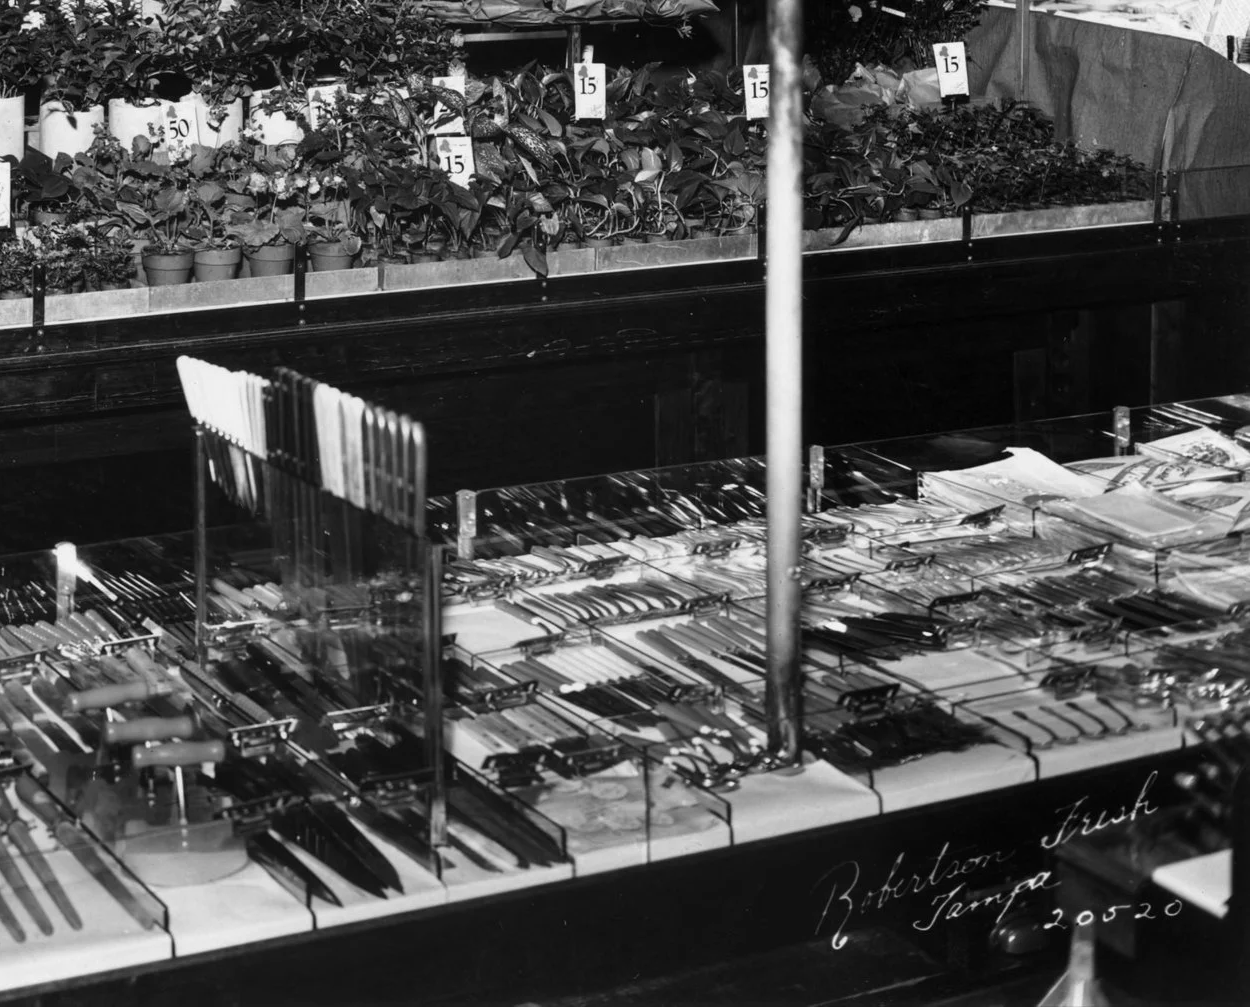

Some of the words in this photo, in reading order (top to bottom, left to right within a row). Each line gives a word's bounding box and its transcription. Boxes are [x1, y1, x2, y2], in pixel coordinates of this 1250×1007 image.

[944, 56, 959, 73] 15
[580, 77, 597, 95] 15
[751, 81, 769, 99] 15
[169, 118, 190, 139] 50
[444, 155, 465, 174] 15
